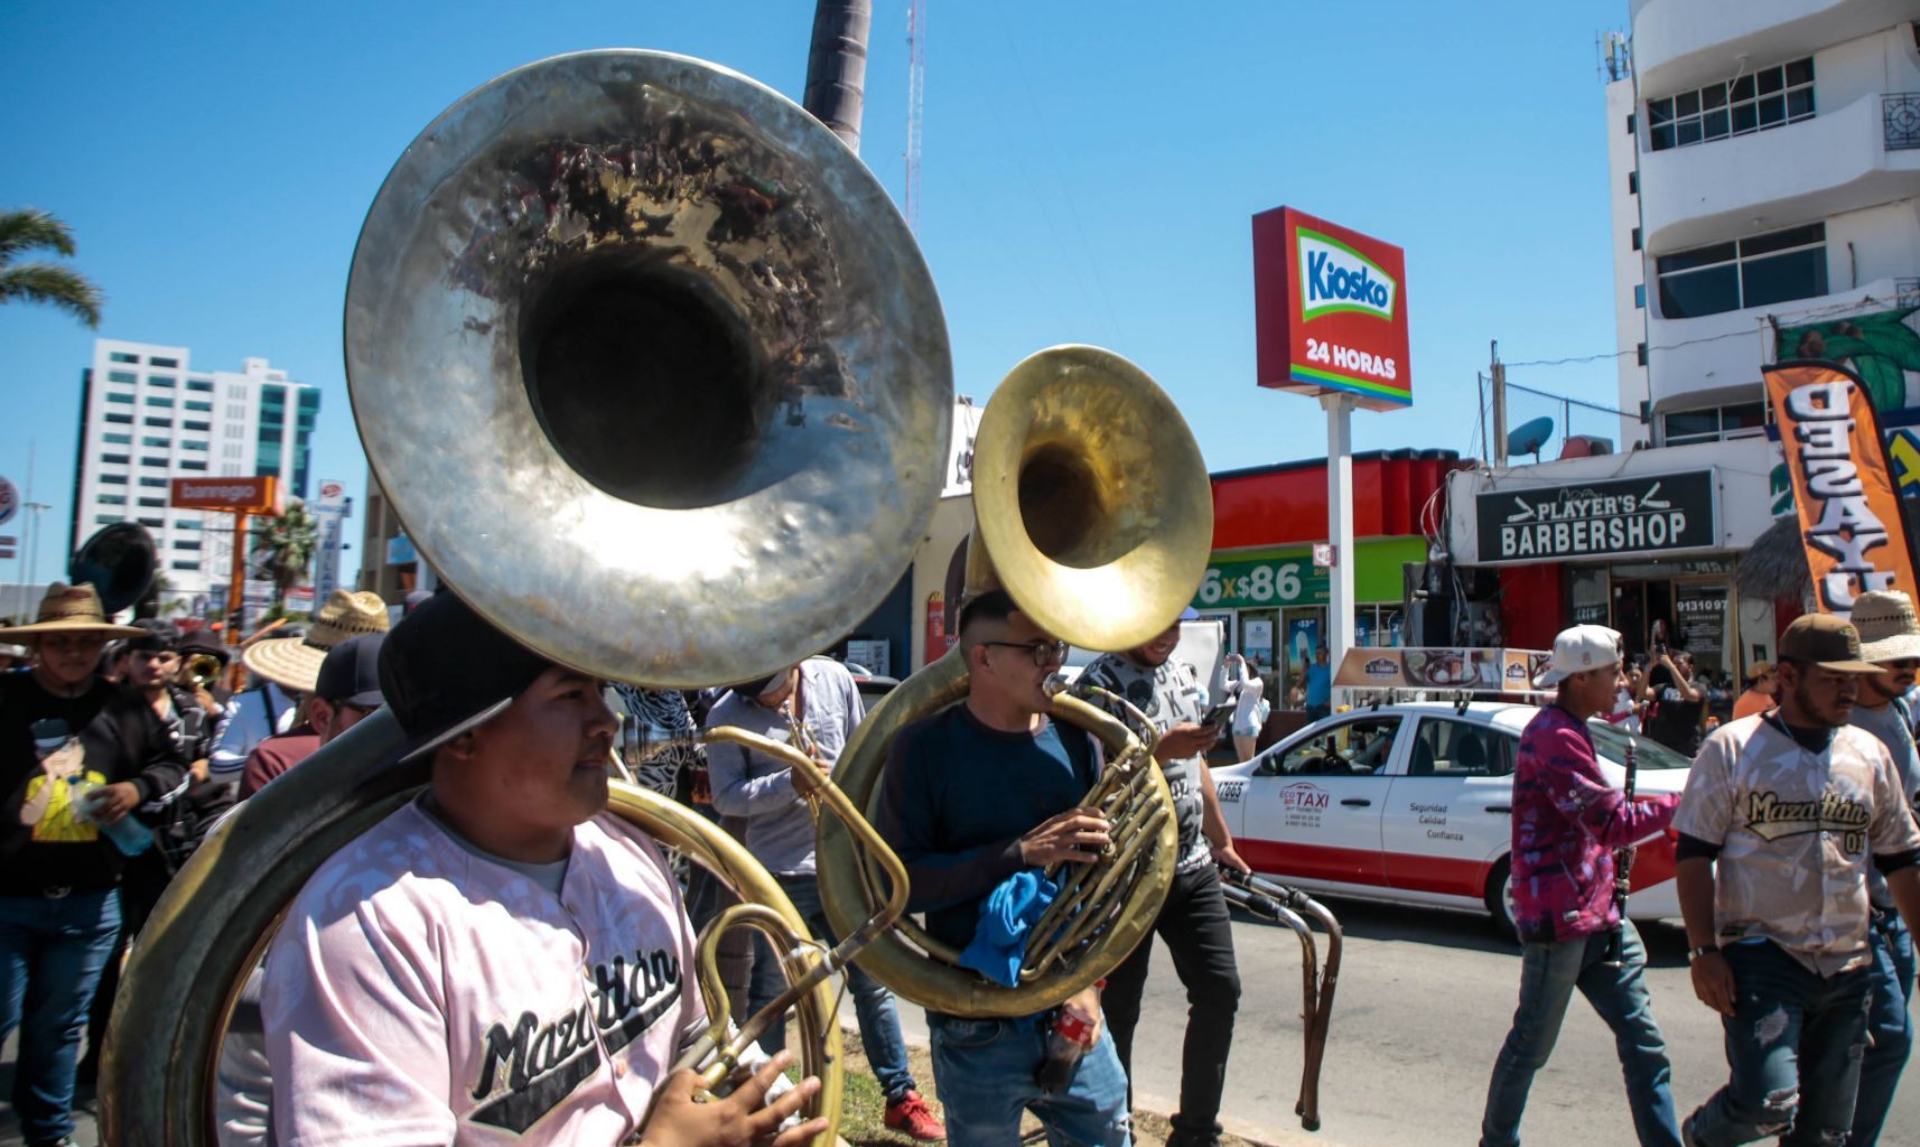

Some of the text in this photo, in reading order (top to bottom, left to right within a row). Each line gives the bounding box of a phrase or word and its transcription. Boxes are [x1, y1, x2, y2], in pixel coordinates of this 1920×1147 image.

[1307, 250, 1389, 309] Kiosko
[1306, 337, 1397, 381] 24 HORAS
[1537, 494, 1636, 522] PLAYER'S
[1501, 511, 1687, 557] BARBERSHOP
[1296, 791, 1330, 809] TAXI
[1409, 801, 1448, 814] Seguridad
[1418, 814, 1447, 826] Calidad
[1426, 828, 1464, 842] Confianza
[471, 948, 682, 1101] Mazatlán
